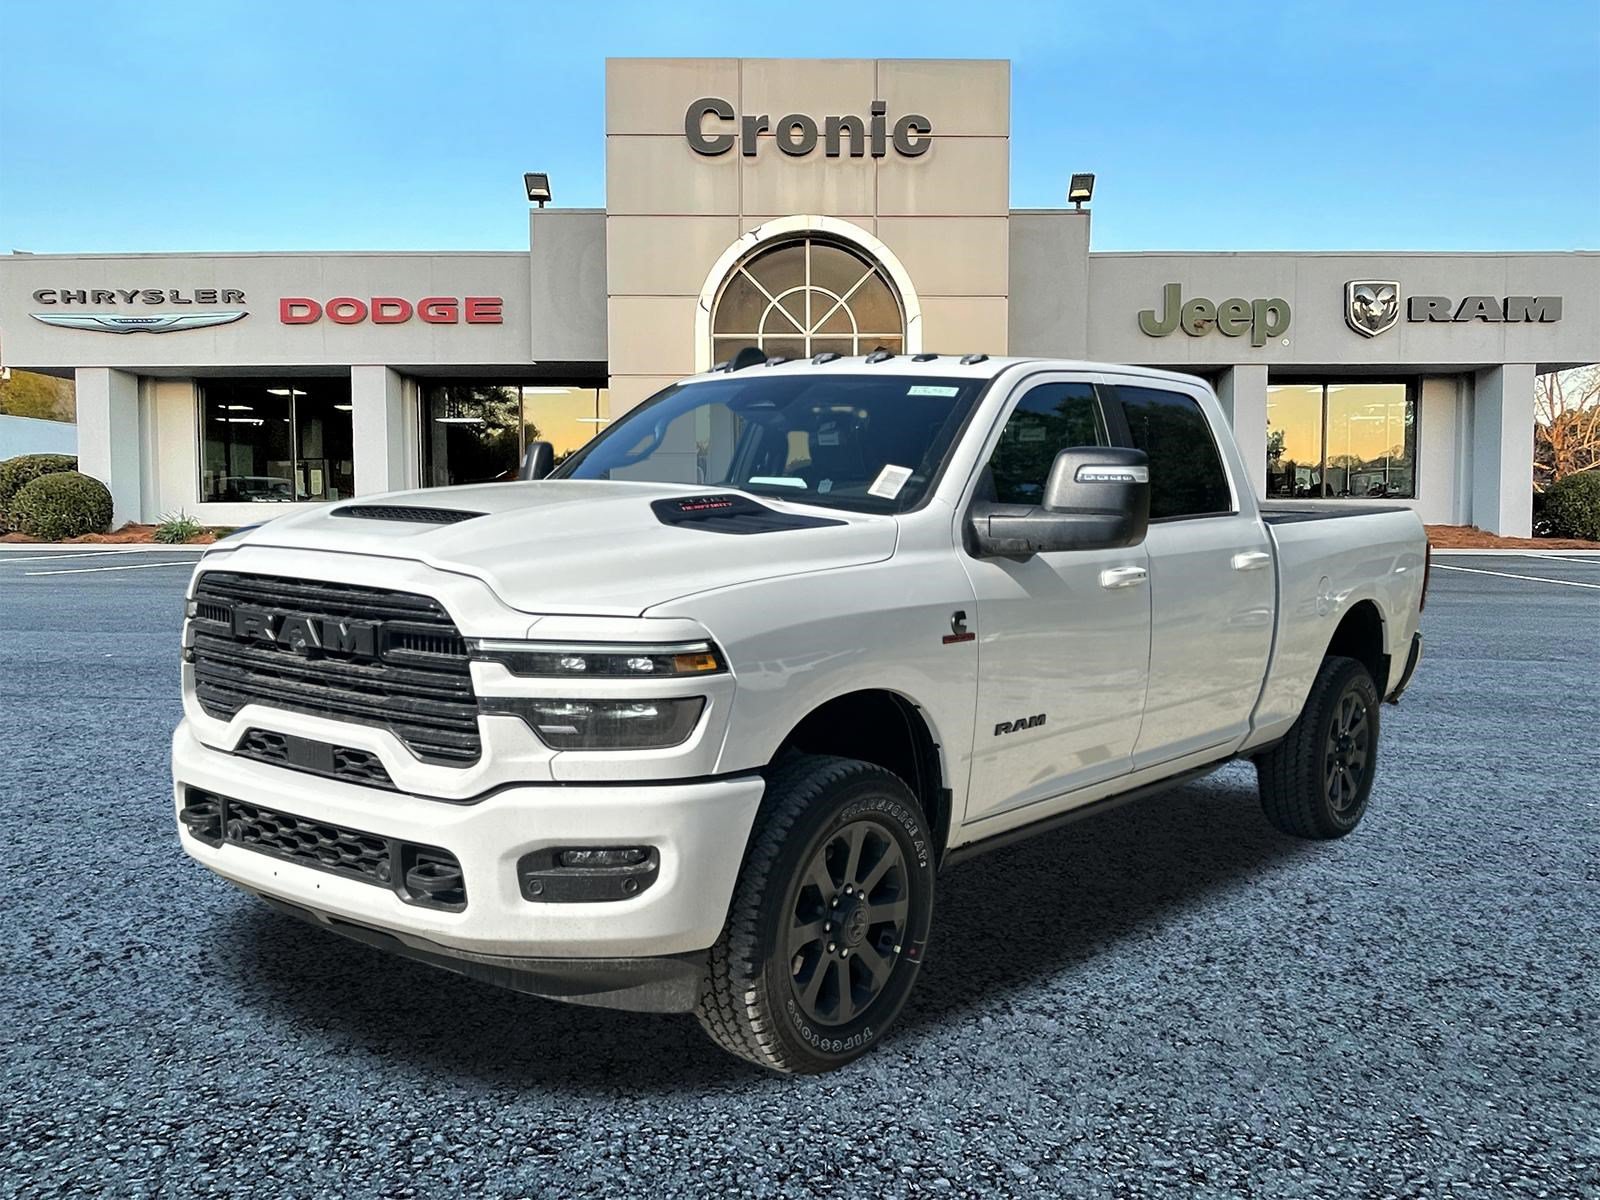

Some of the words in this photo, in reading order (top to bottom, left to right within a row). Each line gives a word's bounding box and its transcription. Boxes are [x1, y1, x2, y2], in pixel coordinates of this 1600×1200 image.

[685, 97, 932, 157] Cronic
[32, 289, 246, 304] CHRYSLER
[1407, 296, 1562, 322] RAM
[280, 297, 503, 324] DODGE
[1138, 283, 1291, 347] Jeep
[234, 606, 374, 656] RAM
[994, 713, 1046, 736] RAM
